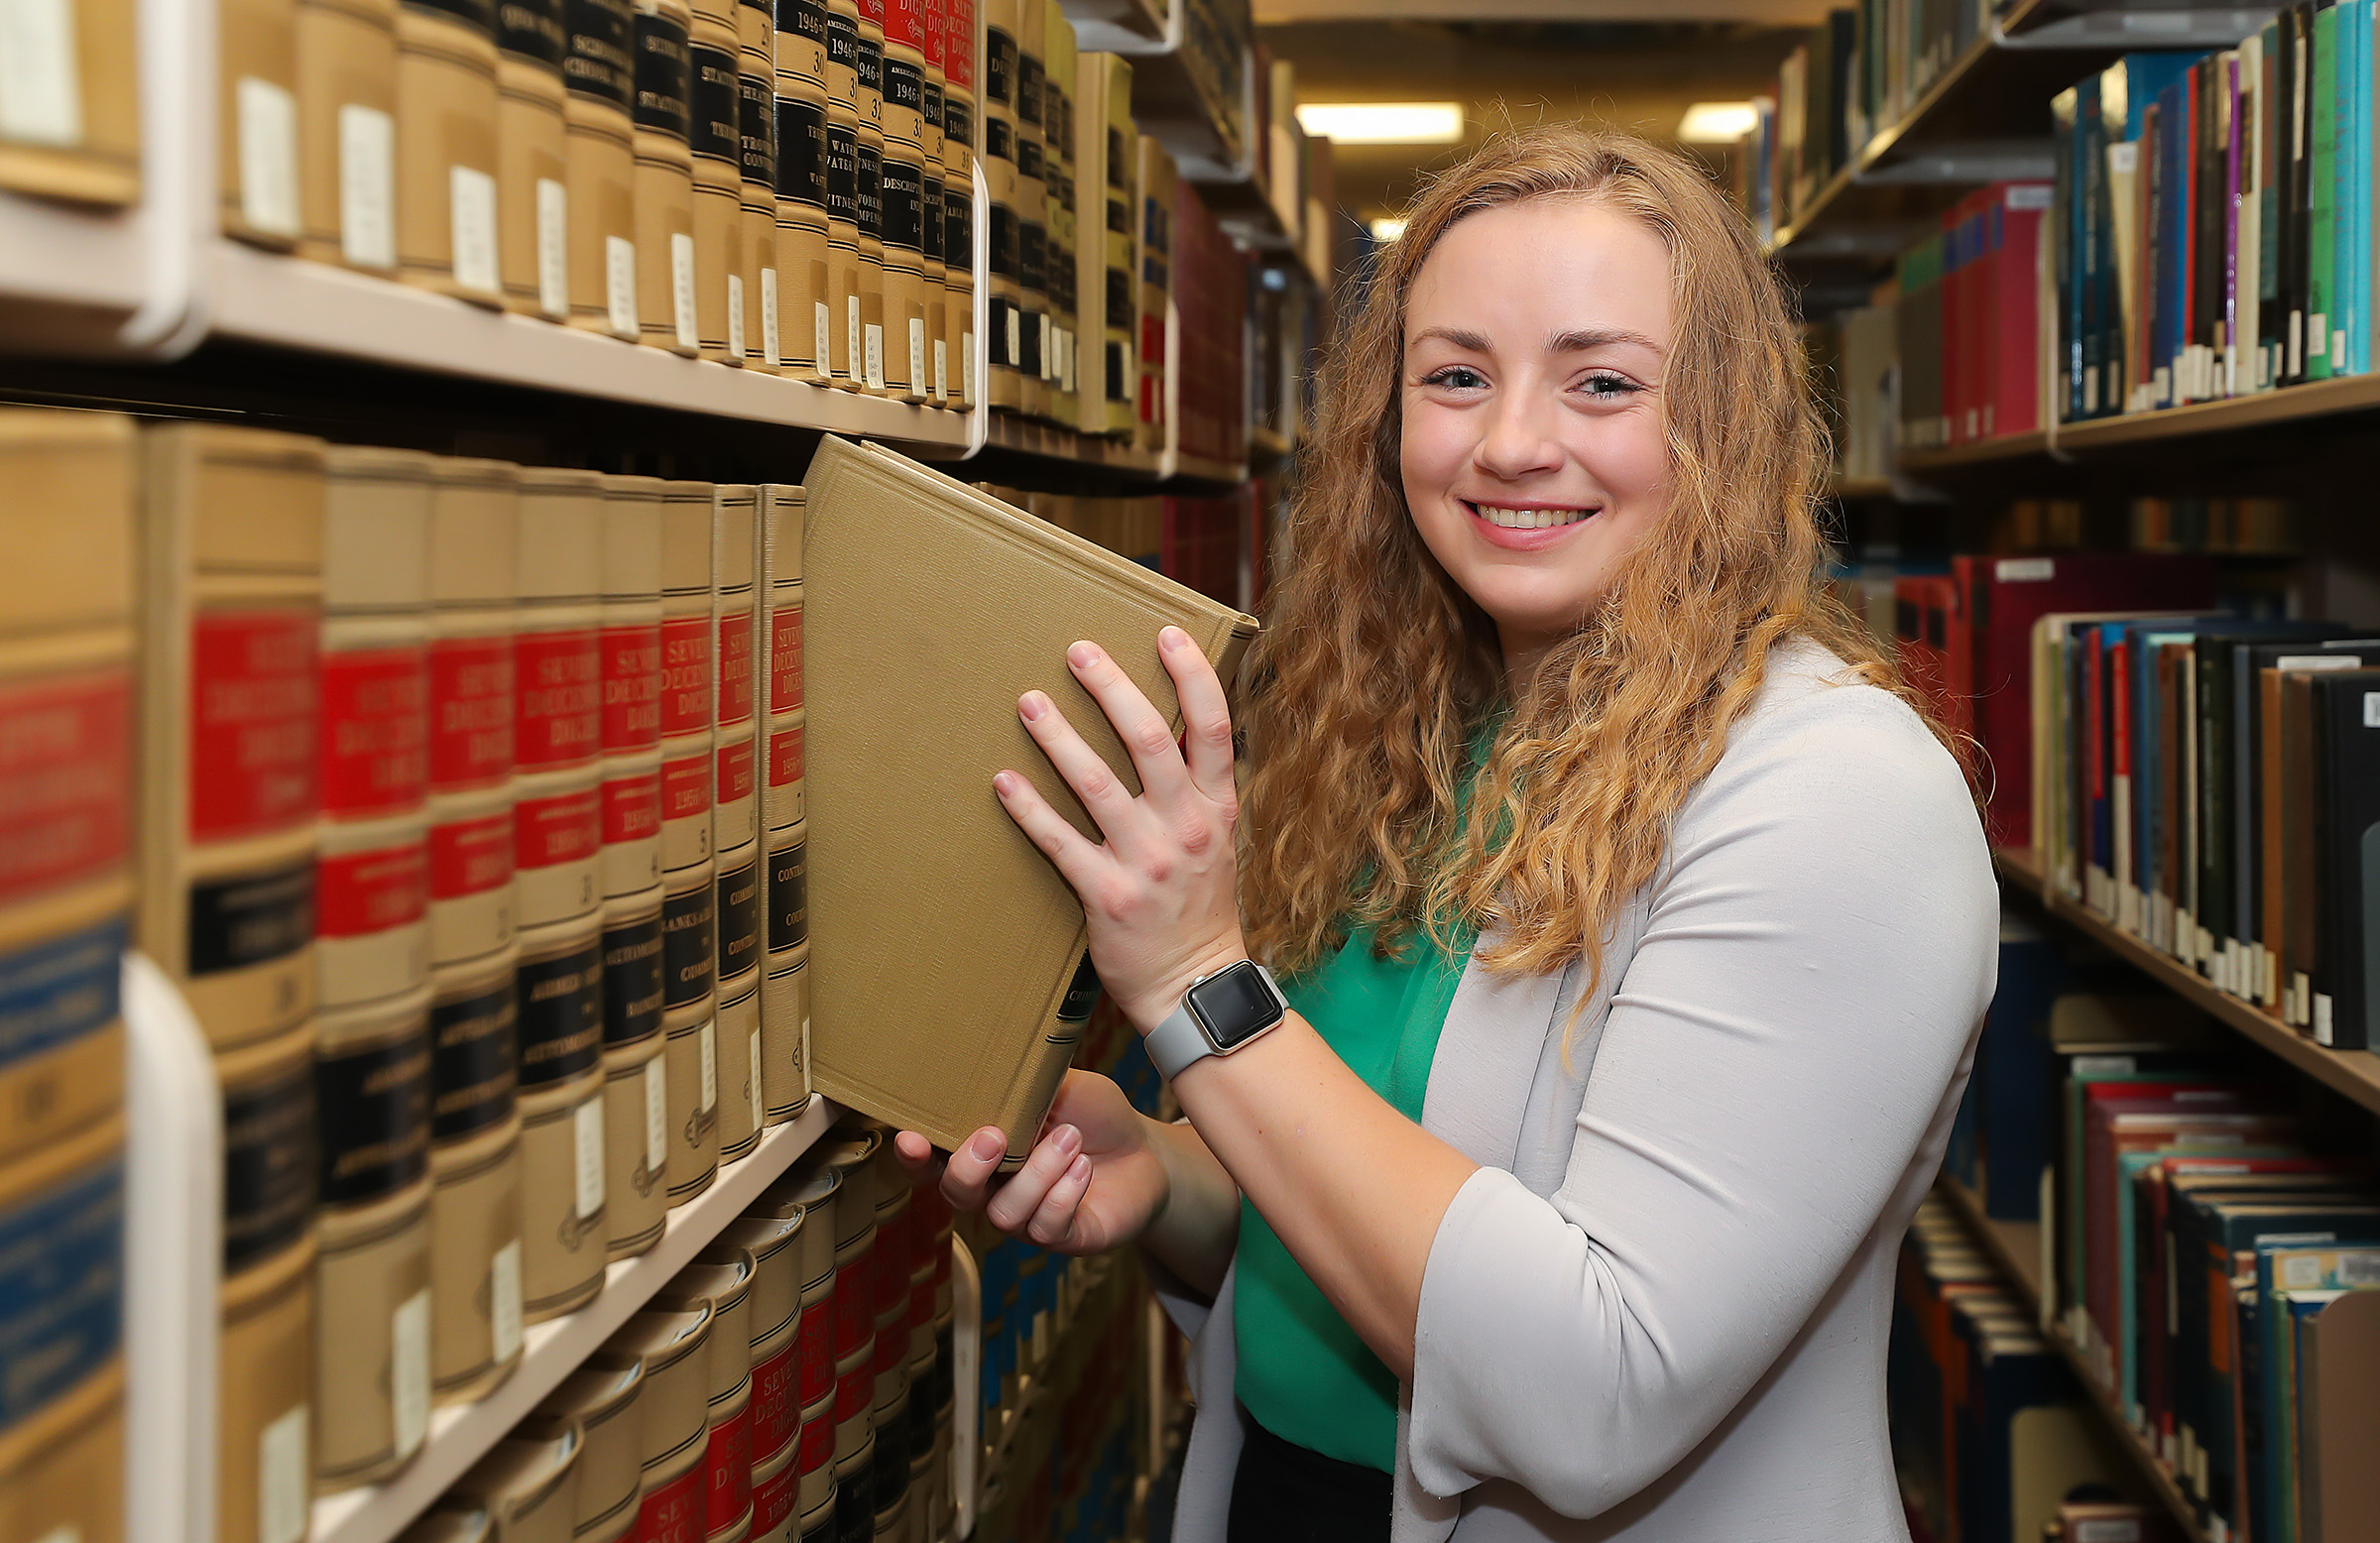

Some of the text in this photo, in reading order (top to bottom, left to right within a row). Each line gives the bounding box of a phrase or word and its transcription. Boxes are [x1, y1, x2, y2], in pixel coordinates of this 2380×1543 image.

[813, 51, 825, 75] 30
[871, 97, 882, 121] 32
[913, 117, 922, 139] 33
[700, 828, 707, 853] 5
